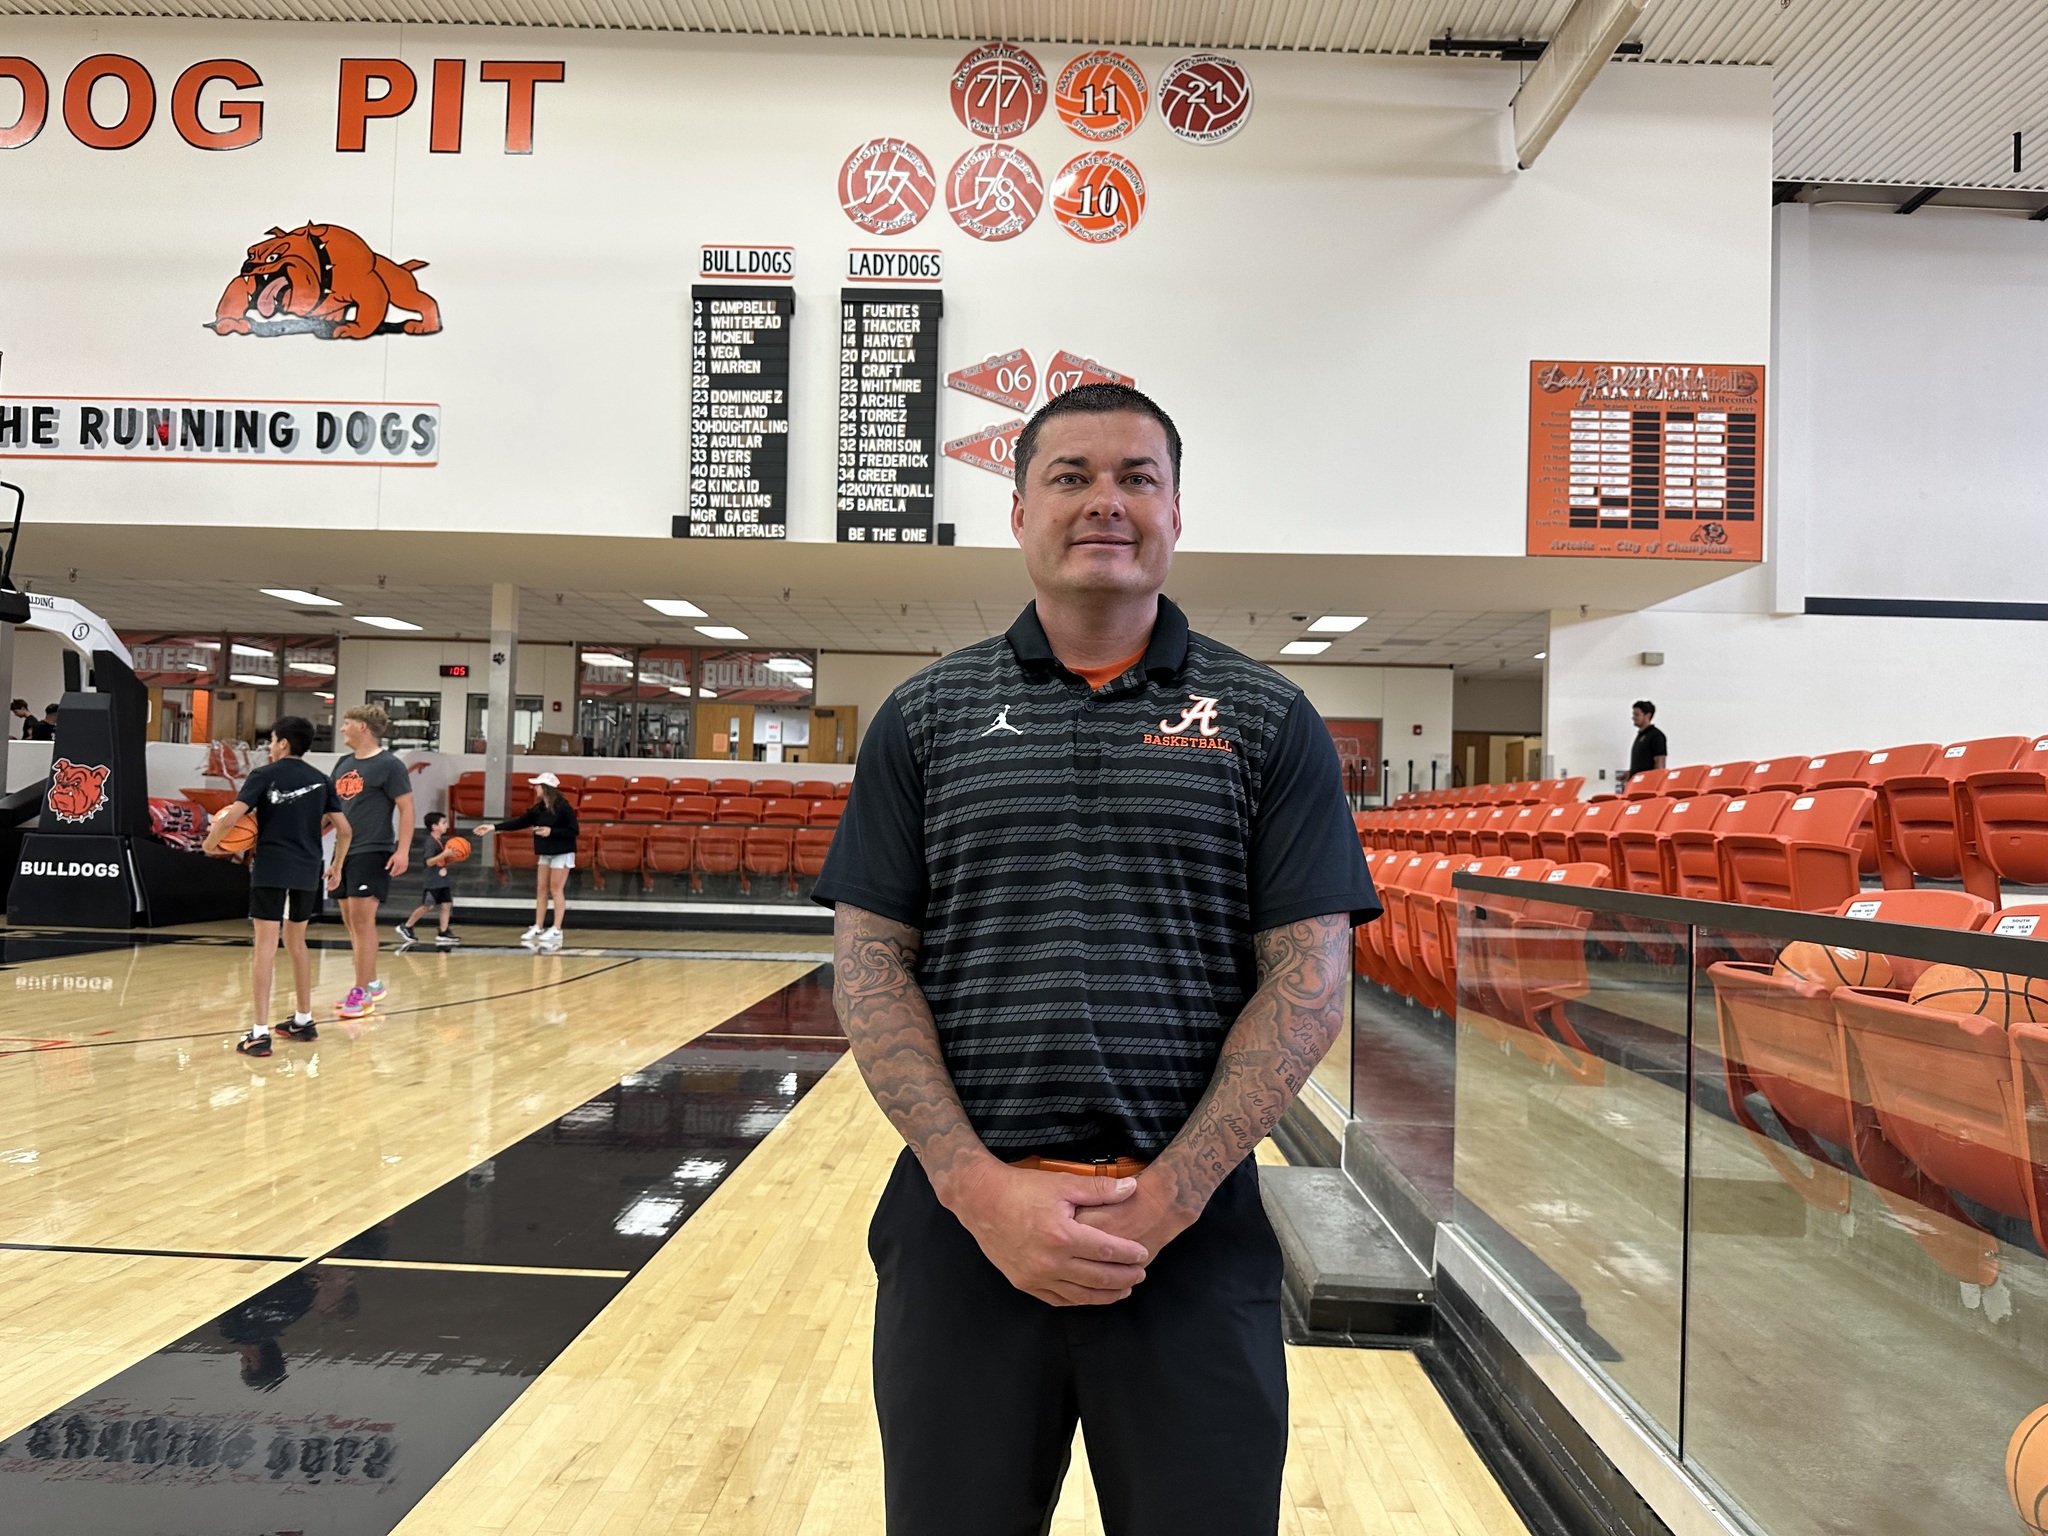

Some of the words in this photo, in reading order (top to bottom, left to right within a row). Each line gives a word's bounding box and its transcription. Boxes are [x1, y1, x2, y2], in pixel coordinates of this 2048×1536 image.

[987, 48, 1014, 60] STATE
[1074, 56, 1100, 71] STATE
[1102, 56, 1145, 92] CHAMPIONS
[1170, 62, 1190, 78] STATE
[1191, 56, 1237, 67] CHAMPIONS
[975, 73, 1023, 108] 77
[1186, 80, 1224, 104] 21
[0, 53, 264, 151] DOG
[336, 58, 566, 155] PIT
[1080, 84, 1121, 116] 11
[1073, 120, 1097, 137] STACY
[1100, 121, 1128, 138] GOWEN
[1200, 122, 1238, 140] WILLIAMS
[861, 144, 886, 158] STATE
[970, 149, 994, 164] STATE
[1072, 157, 1099, 170] STATE
[1101, 157, 1143, 194] CHAMPIONS
[864, 169, 910, 205] 77
[975, 176, 1015, 212] 78
[1076, 184, 1121, 218] 10
[1069, 220, 1094, 238] STACY
[1095, 222, 1125, 240] GOWEN
[703, 250, 792, 274] BULLDOGS
[849, 253, 941, 277] LADYDOGS
[694, 301, 703, 314] 3
[710, 301, 776, 314] CAMPBELL
[844, 304, 854, 318] 11
[862, 304, 919, 318] FUENTES
[693, 316, 703, 329] 4
[710, 316, 782, 329] WHITEHEAD
[843, 319, 856, 333] 12
[863, 319, 920, 333] THACKER
[693, 331, 707, 344] 12
[710, 330, 755, 344] MCNEIL
[842, 334, 856, 348] 14
[863, 335, 914, 348] HARVEY
[693, 345, 706, 359] 14
[710, 346, 741, 359] VEGA
[841, 349, 858, 362] 20
[861, 349, 916, 363] PADILLA
[693, 360, 706, 374] 21
[711, 360, 761, 374] WARREN
[841, 364, 854, 378] 21
[861, 364, 903, 378] CRAFT
[692, 375, 710, 388] 22
[841, 379, 858, 392] 22
[861, 379, 922, 393] WHITMIRE
[996, 364, 1032, 394] 06
[1049, 370, 1083, 398] 07
[1545, 363, 1592, 404] Lady
[692, 390, 709, 403] 23
[840, 394, 857, 407] 23
[860, 394, 906, 408] ARCHIE
[1718, 396, 1758, 404] Records
[692, 405, 708, 418] 24
[711, 405, 768, 419] EGELAND
[840, 409, 857, 422] 24
[860, 409, 907, 423] TORREZ
[79, 405, 296, 450] RUNNING
[316, 410, 437, 454] DOGS
[840, 423, 857, 437] 25
[860, 424, 906, 438] SAVOIE
[691, 434, 708, 448] 32
[710, 434, 763, 448] AGUILAR
[839, 438, 856, 452] 32
[859, 438, 921, 453] HARRISON
[691, 449, 707, 463] 33
[711, 449, 752, 463] BYERS
[839, 453, 855, 467] 33
[859, 453, 928, 468] FREDERICK
[691, 464, 708, 478] 40
[709, 464, 751, 478] DEANS
[838, 468, 855, 482] 34
[857, 468, 897, 482] GREER
[691, 479, 706, 492] 42
[708, 479, 760, 493] KINCAID
[690, 493, 707, 507] 50
[709, 494, 772, 508] WILLIAMS
[837, 498, 854, 511] 45
[857, 498, 906, 512] BARELA
[691, 508, 717, 522] MGR
[724, 509, 759, 523] GAGE
[848, 527, 865, 541] BE
[872, 528, 896, 542] THE
[901, 528, 927, 542] ONE
[1550, 539, 1595, 552] Artesia
[1616, 540, 1641, 554] City
[1646, 541, 1661, 555] of
[1666, 542, 1732, 556] Champions
[1158, 694, 1220, 736] A
[1143, 733, 1233, 753] BASKETBALL
[20, 861, 120, 878] BULLDOGS
[1247, 1089, 1264, 1107] be
[1221, 1112, 1249, 1142] than
